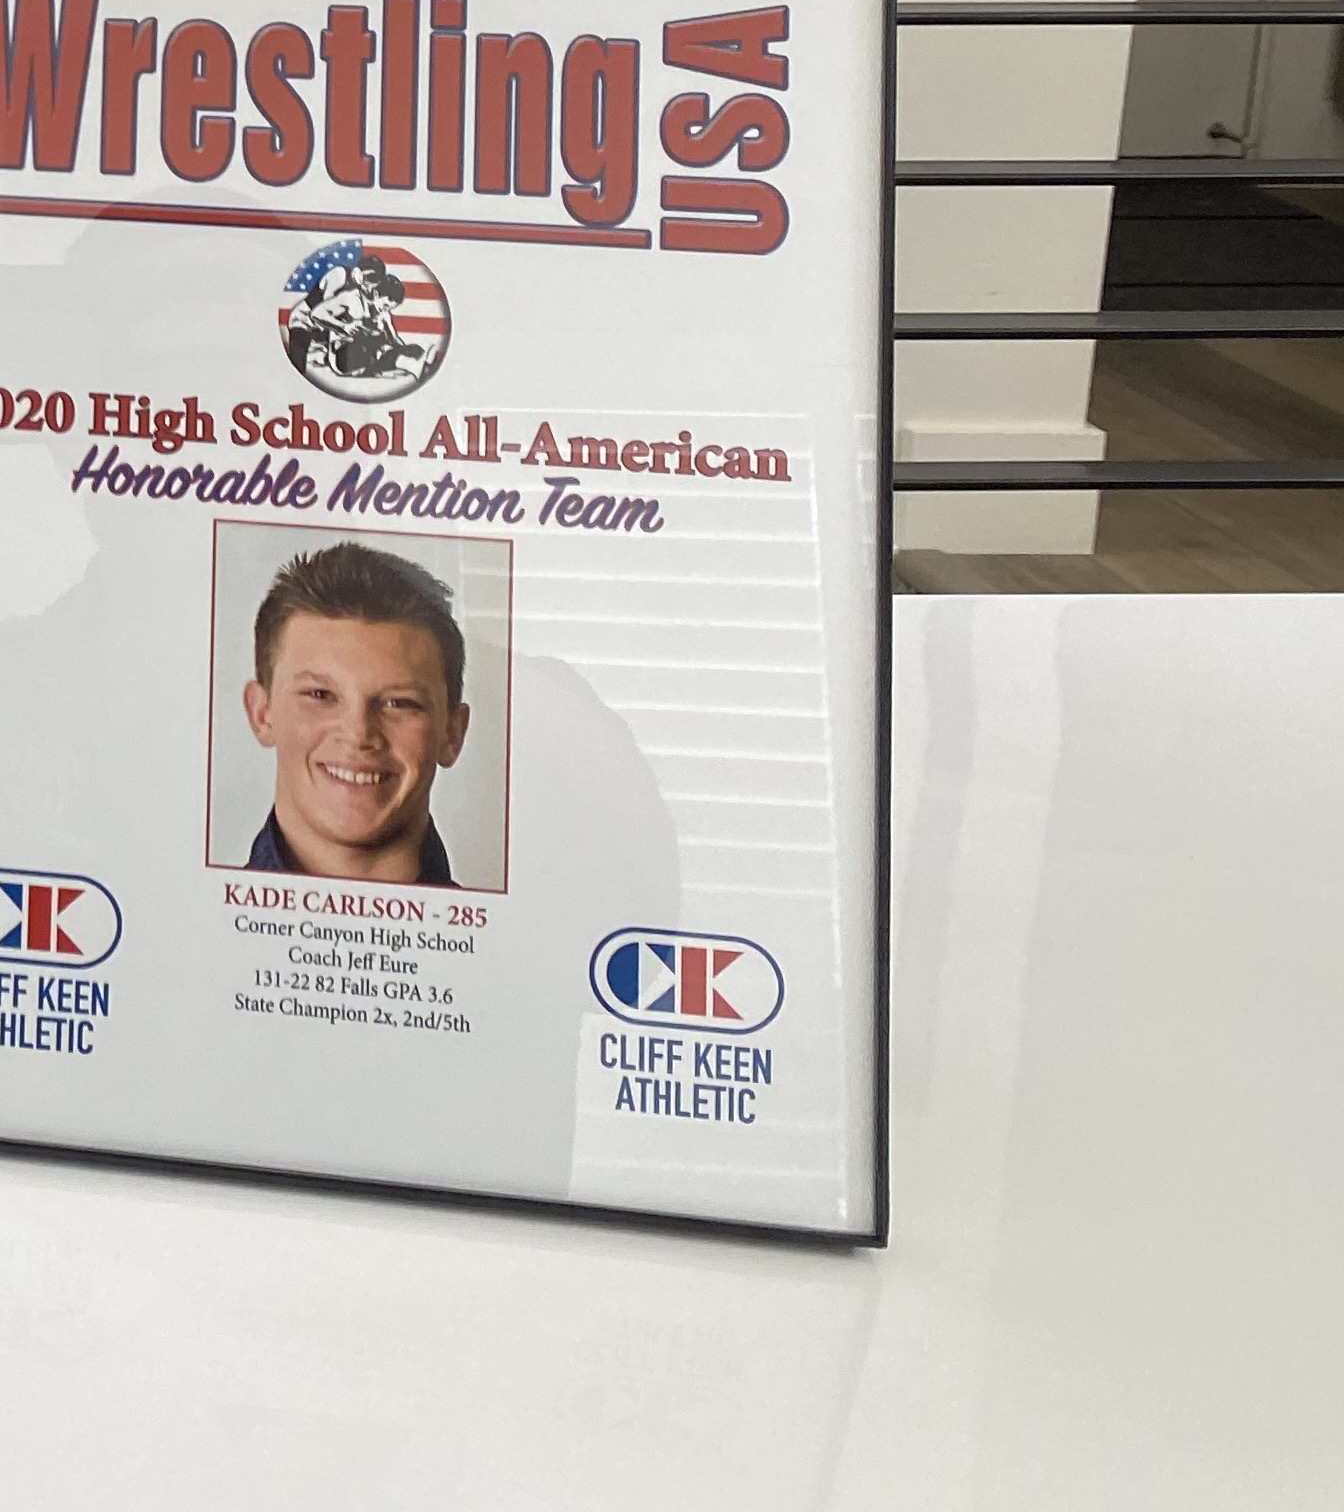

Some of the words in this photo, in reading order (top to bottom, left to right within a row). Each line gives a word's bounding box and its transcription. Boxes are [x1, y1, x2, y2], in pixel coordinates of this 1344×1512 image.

[659, 4, 790, 255] USA
[88, 393, 217, 454] High
[230, 402, 408, 457] School
[420, 414, 792, 482] All-American
[72, 444, 318, 509] Honorable
[327, 462, 525, 523] Mention
[539, 476, 665, 533] Team
[224, 884, 297, 911] KADE
[303, 891, 426, 922] CARLSON
[447, 905, 488, 928] 285
[234, 914, 295, 936] Corner
[300, 921, 364, 947] Canyon
[370, 927, 411, 952] High
[417, 931, 475, 953] School
[288, 946, 342, 968] Coach
[348, 951, 376, 972] Jeff
[380, 955, 418, 974] Eure
[38, 976, 109, 1017] KEEN
[254, 969, 310, 990] 131-22
[315, 975, 335, 993] 82
[340, 976, 378, 997] Falls
[383, 981, 422, 1001] GPA
[428, 987, 453, 1005] 3.6
[234, 993, 274, 1013] State
[279, 997, 368, 1024] Champion
[373, 1007, 398, 1027] 2x,
[403, 1010, 471, 1033] 2nd/5th
[600, 1033, 683, 1075] CLIFF
[695, 1042, 772, 1085] KEEN
[615, 1075, 756, 1124] ATHLETIC
